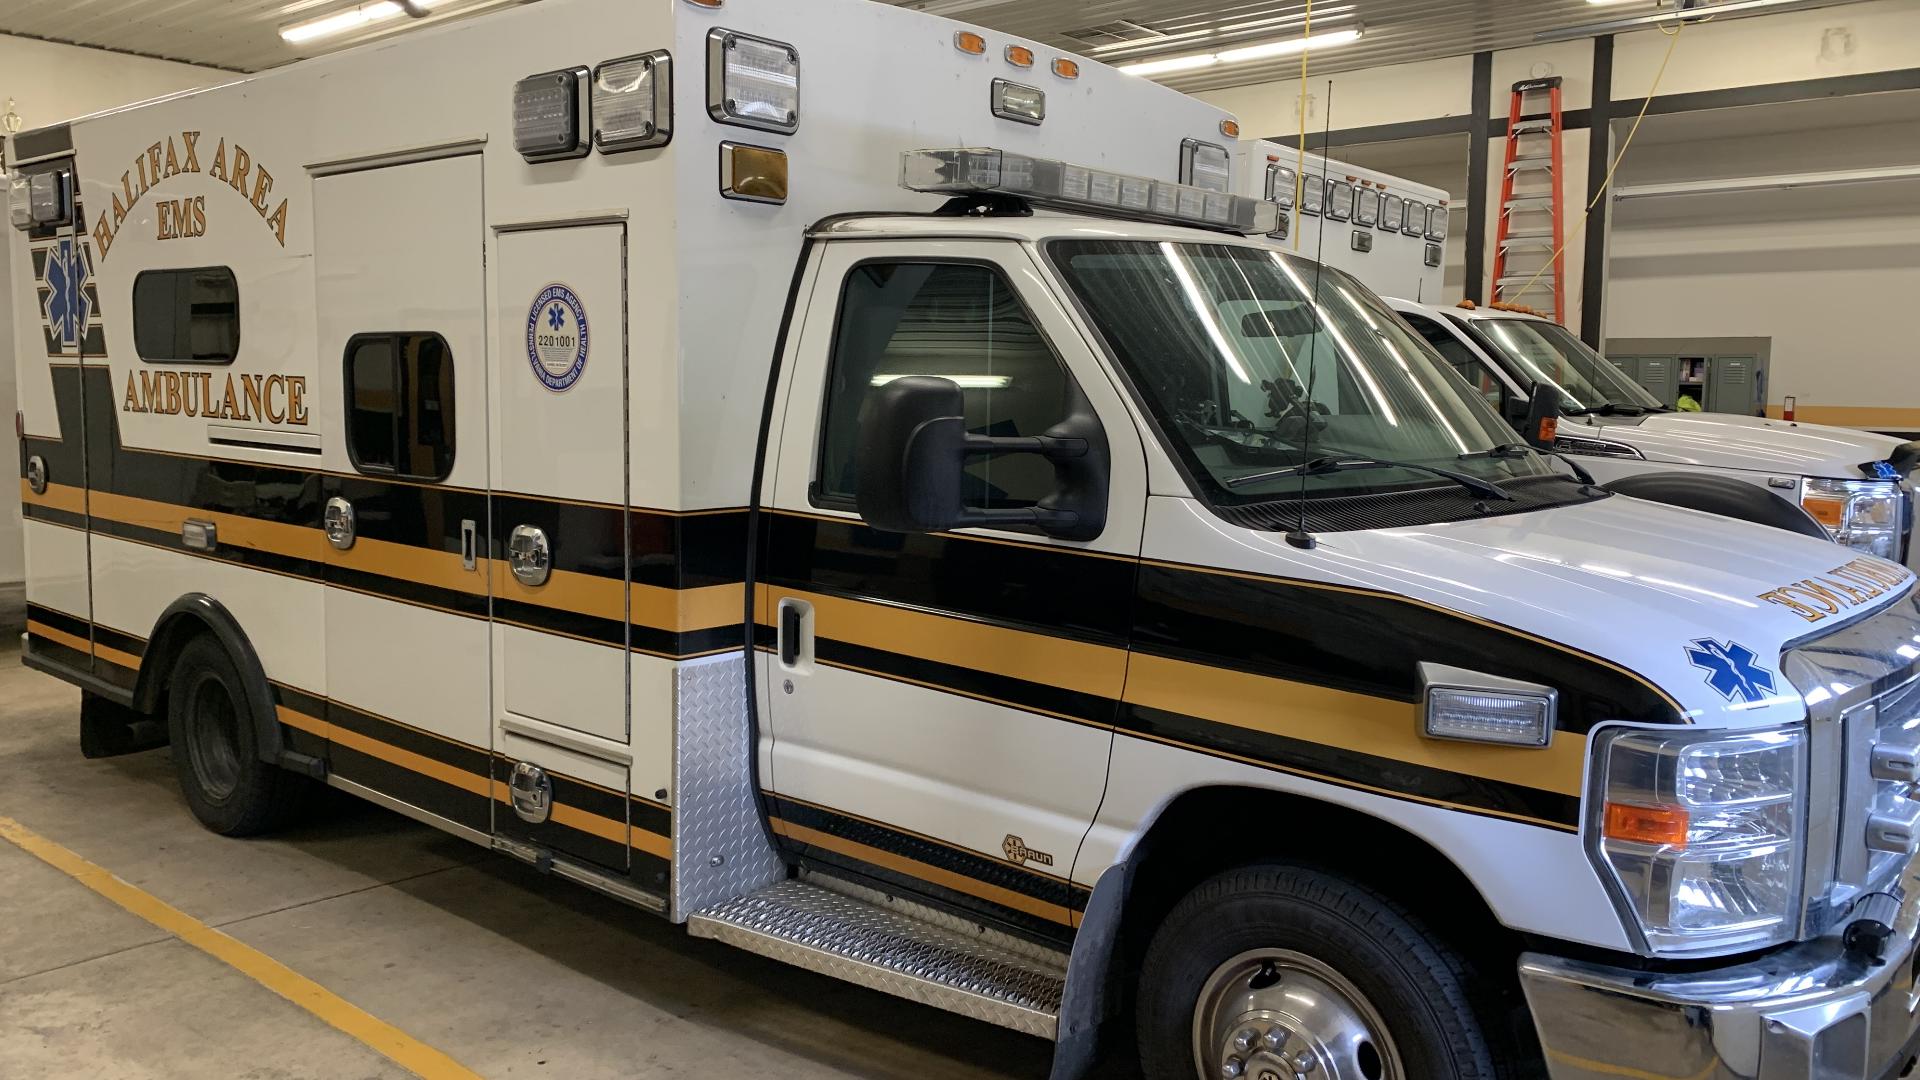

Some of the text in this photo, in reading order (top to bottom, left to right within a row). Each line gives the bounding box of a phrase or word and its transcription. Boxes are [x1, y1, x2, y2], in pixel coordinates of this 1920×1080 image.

[93, 131, 288, 263] HALIFAX AREA
[156, 195, 207, 240] EMS
[530, 287, 584, 322] LICENSED EMS AGENCY
[538, 335, 576, 348] 2201001
[576, 356, 584, 370] OF
[123, 369, 309, 426] AMBULANCE
